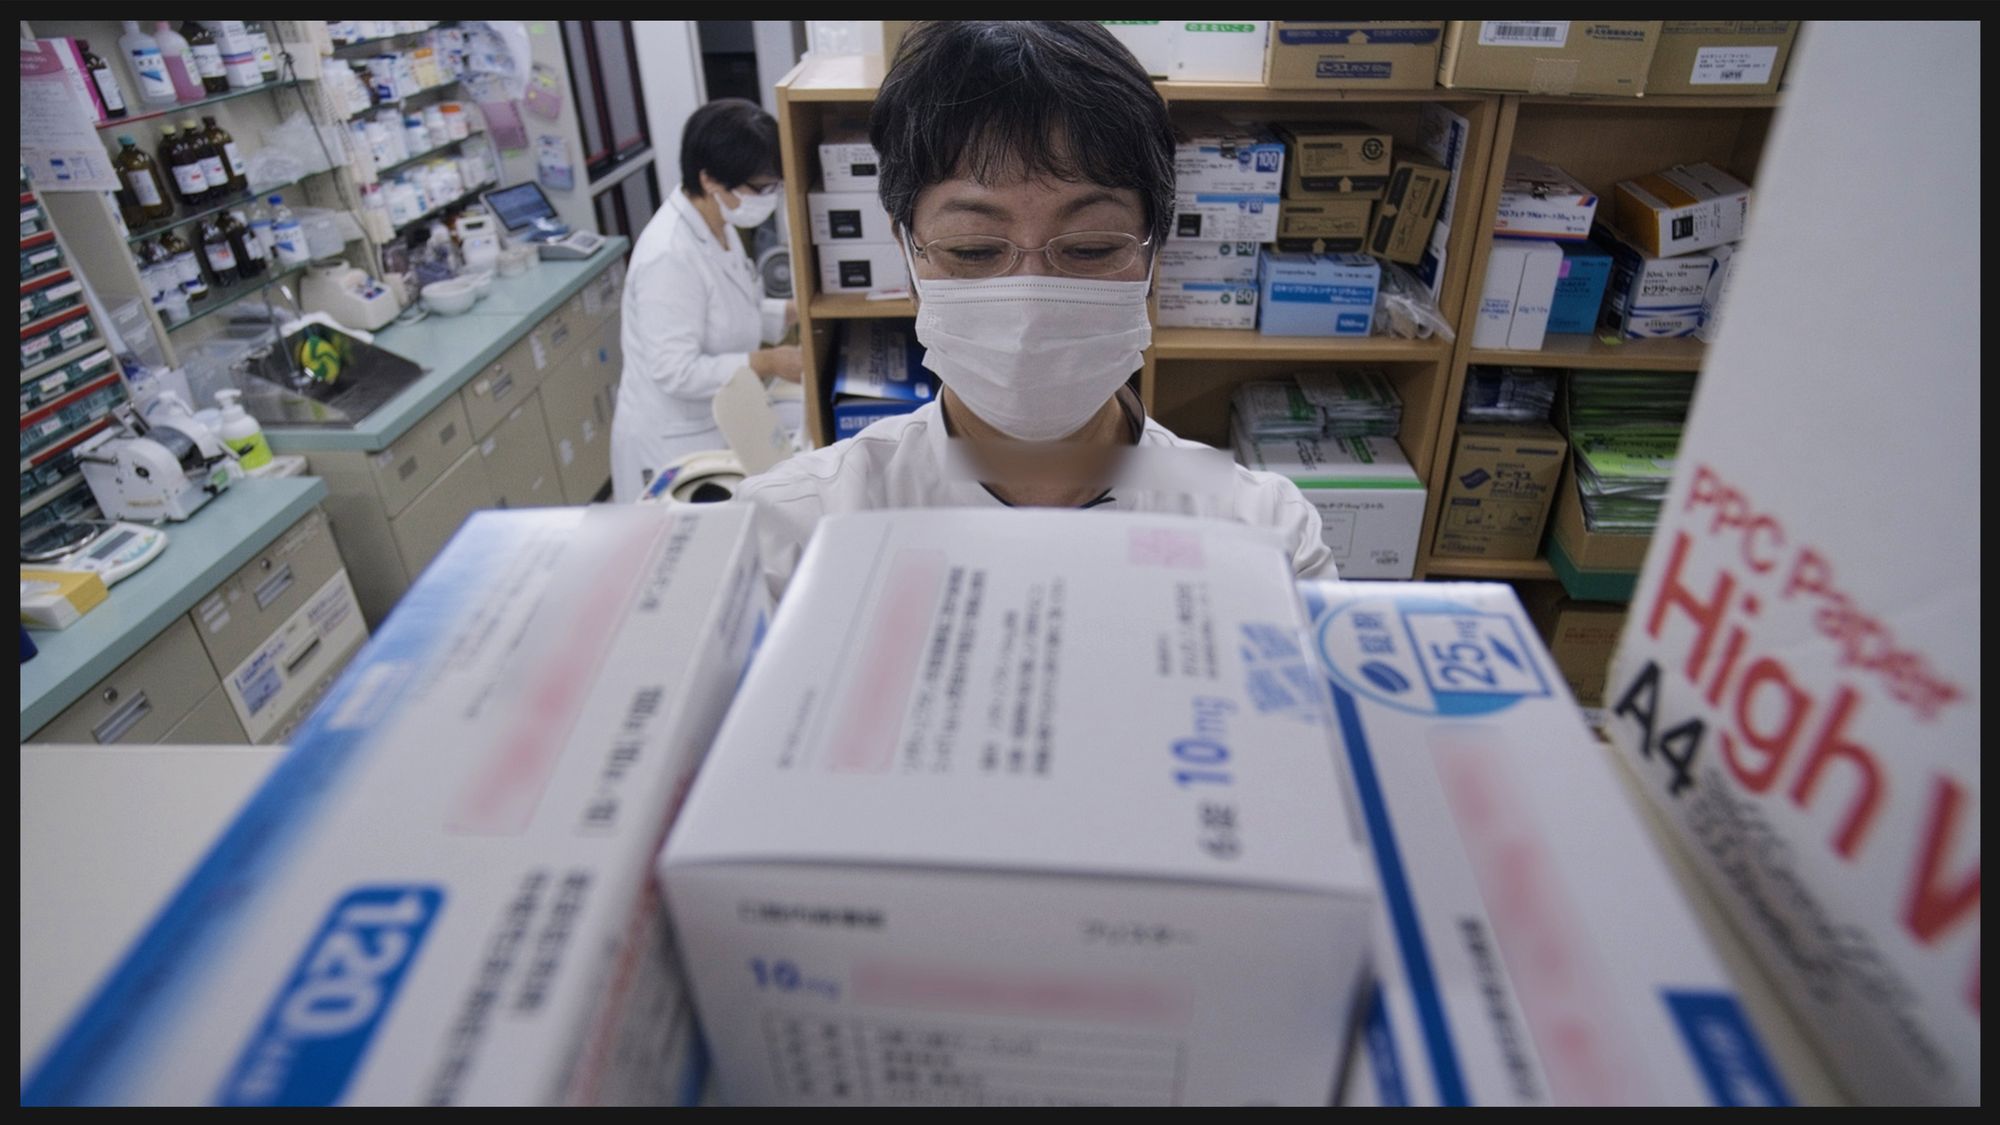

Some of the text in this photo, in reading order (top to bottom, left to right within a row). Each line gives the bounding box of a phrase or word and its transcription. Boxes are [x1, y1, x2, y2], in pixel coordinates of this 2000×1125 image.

[1258, 152, 1278, 167] 100
[1684, 463, 1966, 722] PPC Paper
[1611, 658, 1706, 800] A4
[1645, 528, 1887, 862] High
[281, 897, 424, 1037] 120
[749, 957, 841, 1000] 10mg
